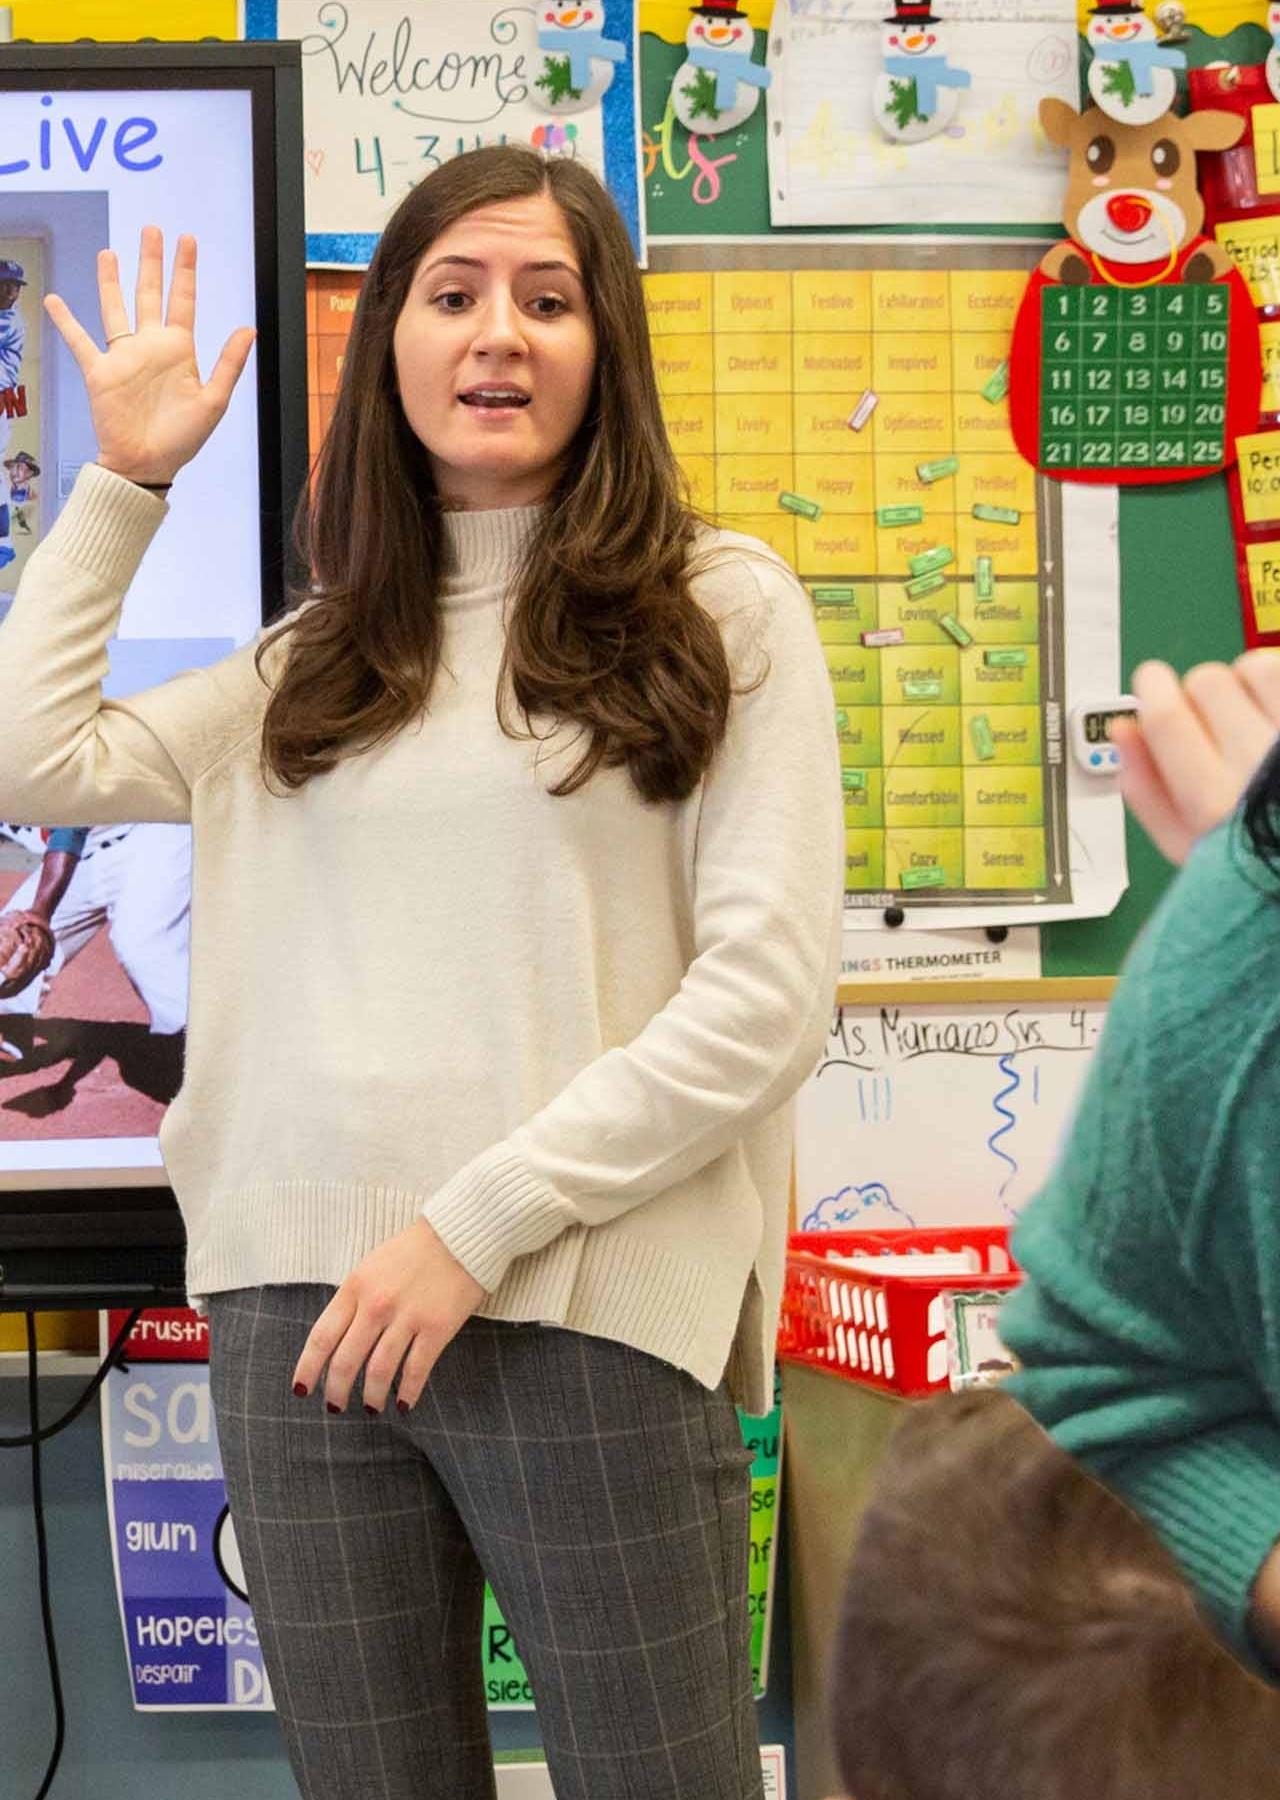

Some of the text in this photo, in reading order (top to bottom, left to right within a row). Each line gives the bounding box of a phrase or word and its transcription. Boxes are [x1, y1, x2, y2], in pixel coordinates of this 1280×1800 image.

[310, 14, 529, 108] Welcome
[0, 94, 163, 175] ive
[1223, 237, 1279, 263] Period
[1059, 294, 1223, 315] 1 2 3 4 5
[1054, 331, 1226, 352] 6 7 8 9 10
[728, 356, 778, 372] Cheerful
[1052, 369, 1224, 389] 11 12 13 14 15
[737, 417, 770, 434] Lively
[1050, 404, 1225, 426] 16 17 18 19 20
[1046, 441, 1223, 463] 21 22 23 24 25
[816, 478, 855, 495] Happy
[887, 790, 960, 806] Comfortable
[977, 790, 1027, 804] Carefree
[982, 851, 1024, 866] Serene
[885, 950, 1002, 971] THERMOMETER
